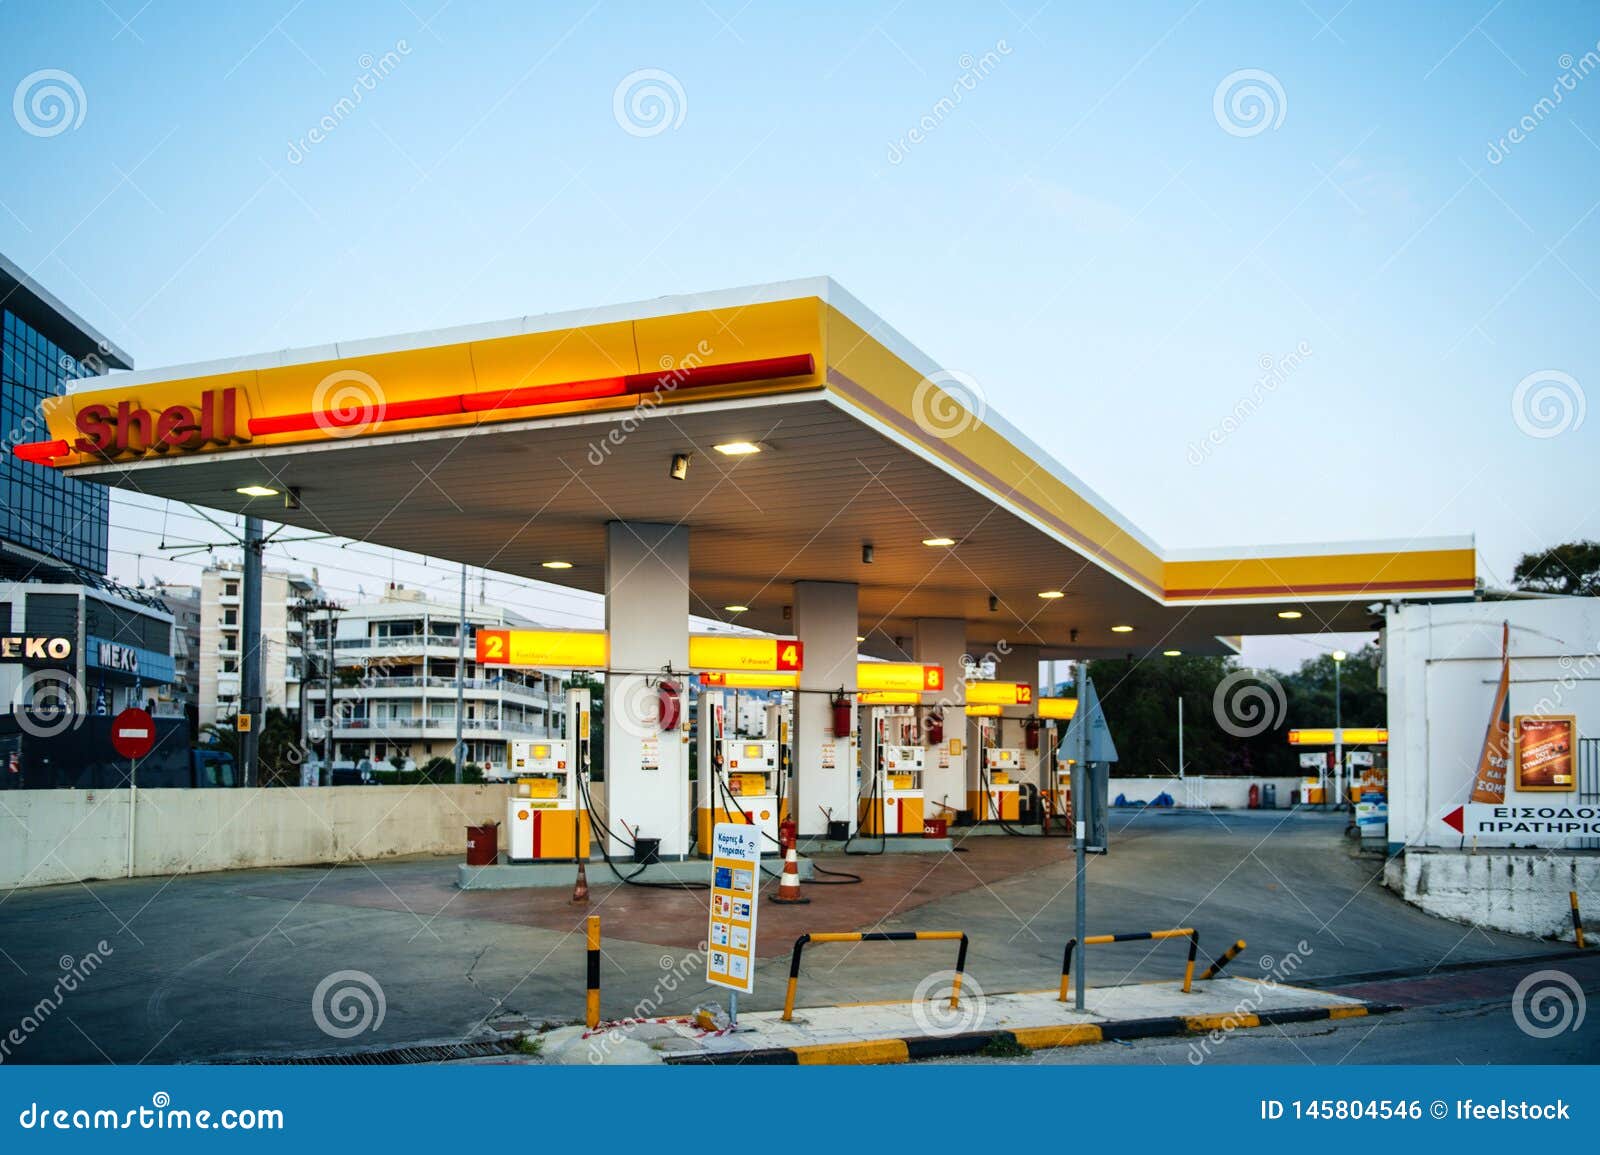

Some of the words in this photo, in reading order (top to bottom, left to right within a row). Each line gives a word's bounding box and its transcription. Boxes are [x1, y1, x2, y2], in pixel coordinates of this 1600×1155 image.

[75, 387, 237, 452] Shell
[484, 636, 503, 658] 2
[782, 645, 798, 666] 4
[928, 670, 940, 687] 8
[1016, 687, 1031, 702] 12
